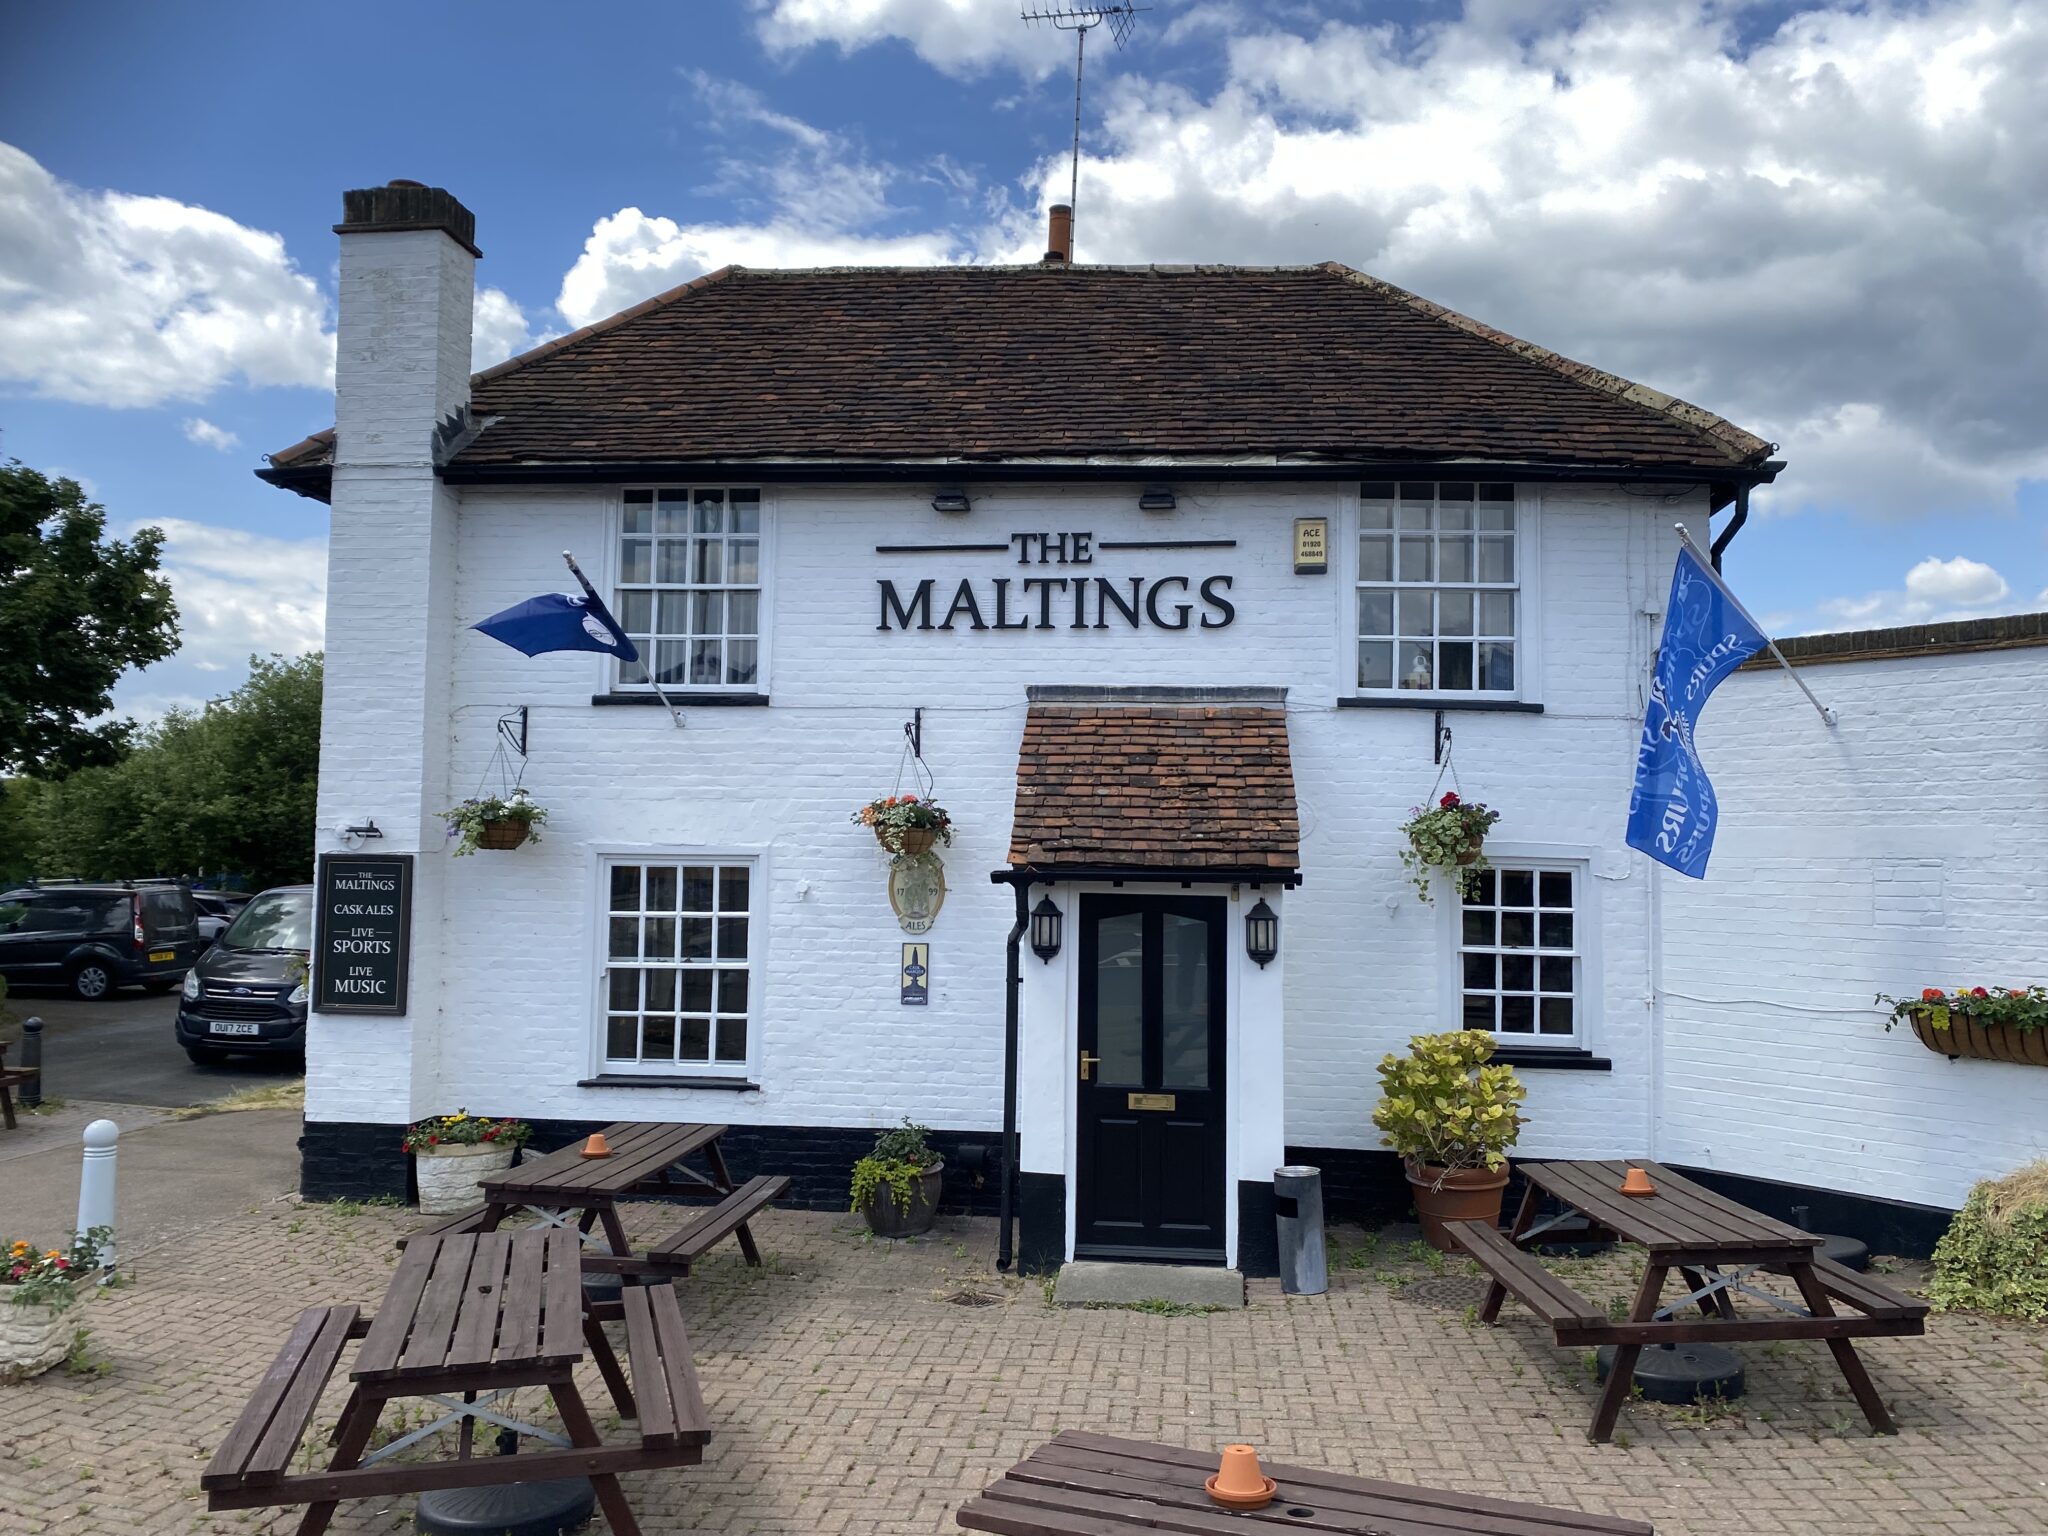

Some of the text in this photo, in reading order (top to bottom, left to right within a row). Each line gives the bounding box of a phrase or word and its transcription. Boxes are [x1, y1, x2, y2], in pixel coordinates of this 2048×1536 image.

[1303, 528, 1321, 537] ACE
[1011, 532, 1093, 564] THE
[876, 575, 1236, 631] MALTINGS
[335, 879, 395, 891] MALTINGS
[334, 904, 394, 916] CASK ALES
[905, 921, 926, 930] ALES
[351, 928, 374, 938] LIVE
[333, 940, 391, 954] SPORTS
[349, 966, 373, 976] LIVE
[334, 979, 387, 994] MUSIC
[236, 1024, 253, 1033] ZCE
